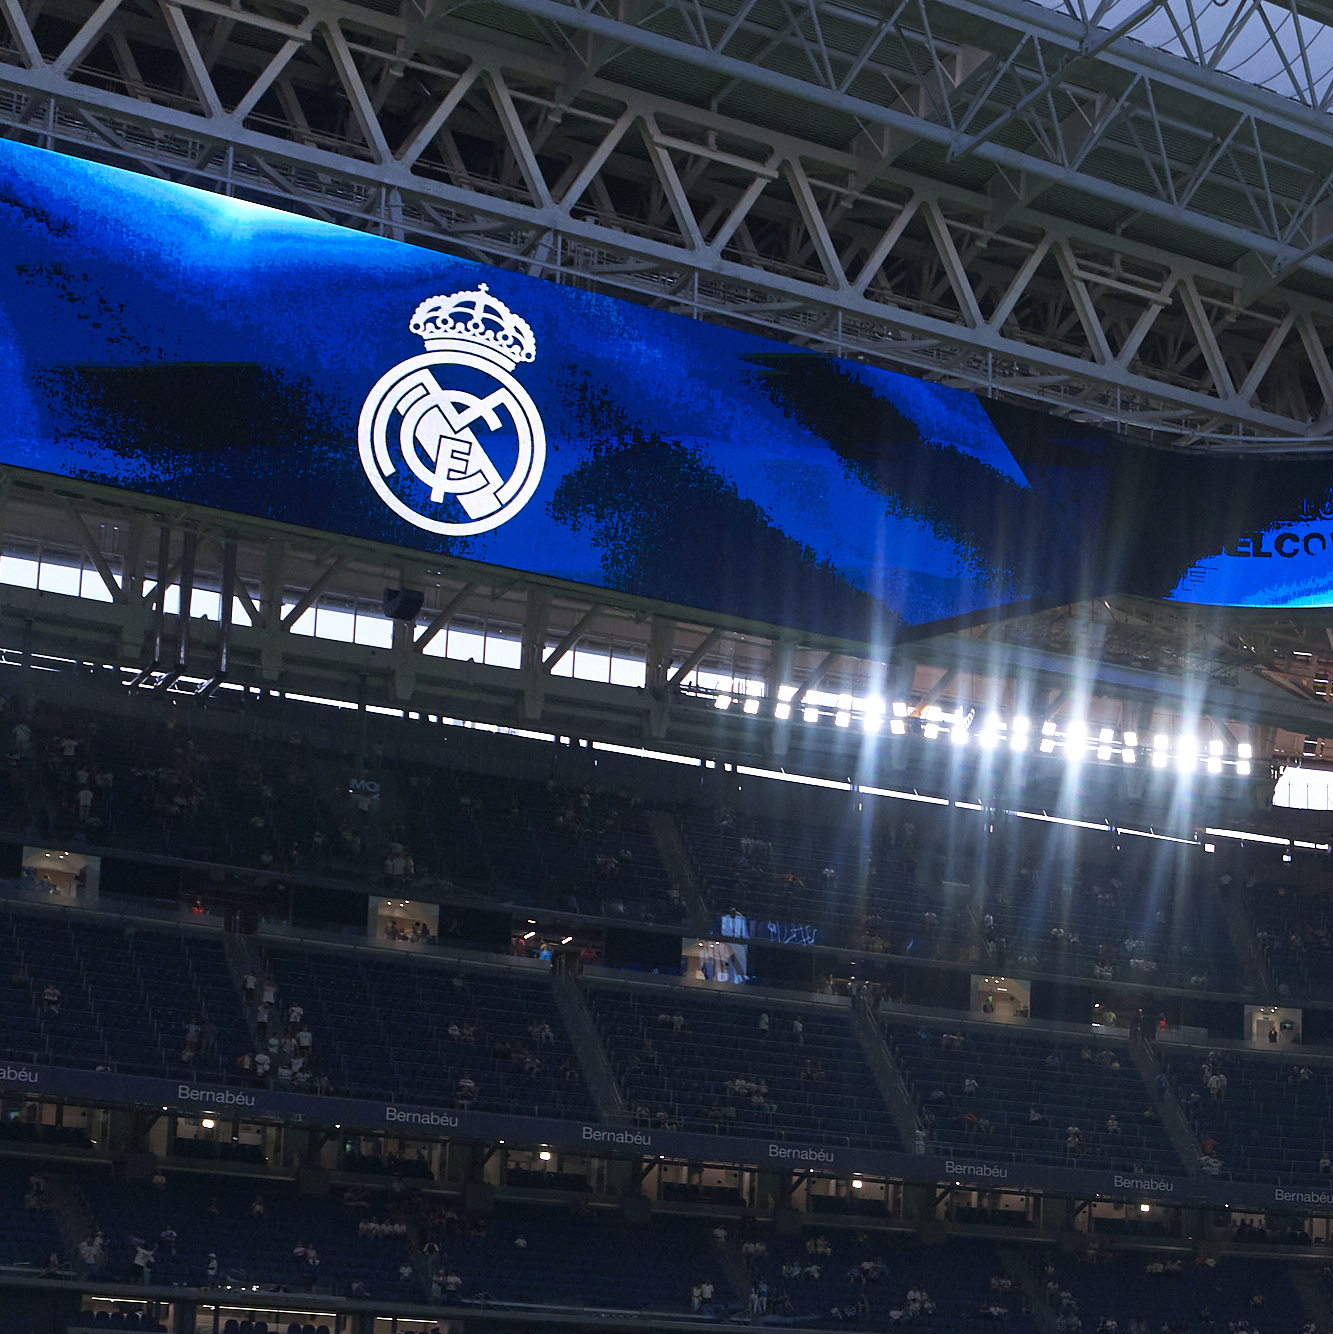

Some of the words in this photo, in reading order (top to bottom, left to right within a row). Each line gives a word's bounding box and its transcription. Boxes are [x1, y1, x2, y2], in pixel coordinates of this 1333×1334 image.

[178, 1085, 255, 1107] Bernabéu
[386, 1106, 459, 1127] Bernabéu
[582, 1126, 651, 1146] Bernabéu
[768, 1144, 834, 1162] Bernabéu
[945, 1160, 1008, 1178] Bernabéu
[1114, 1175, 1174, 1192] Bernabéu
